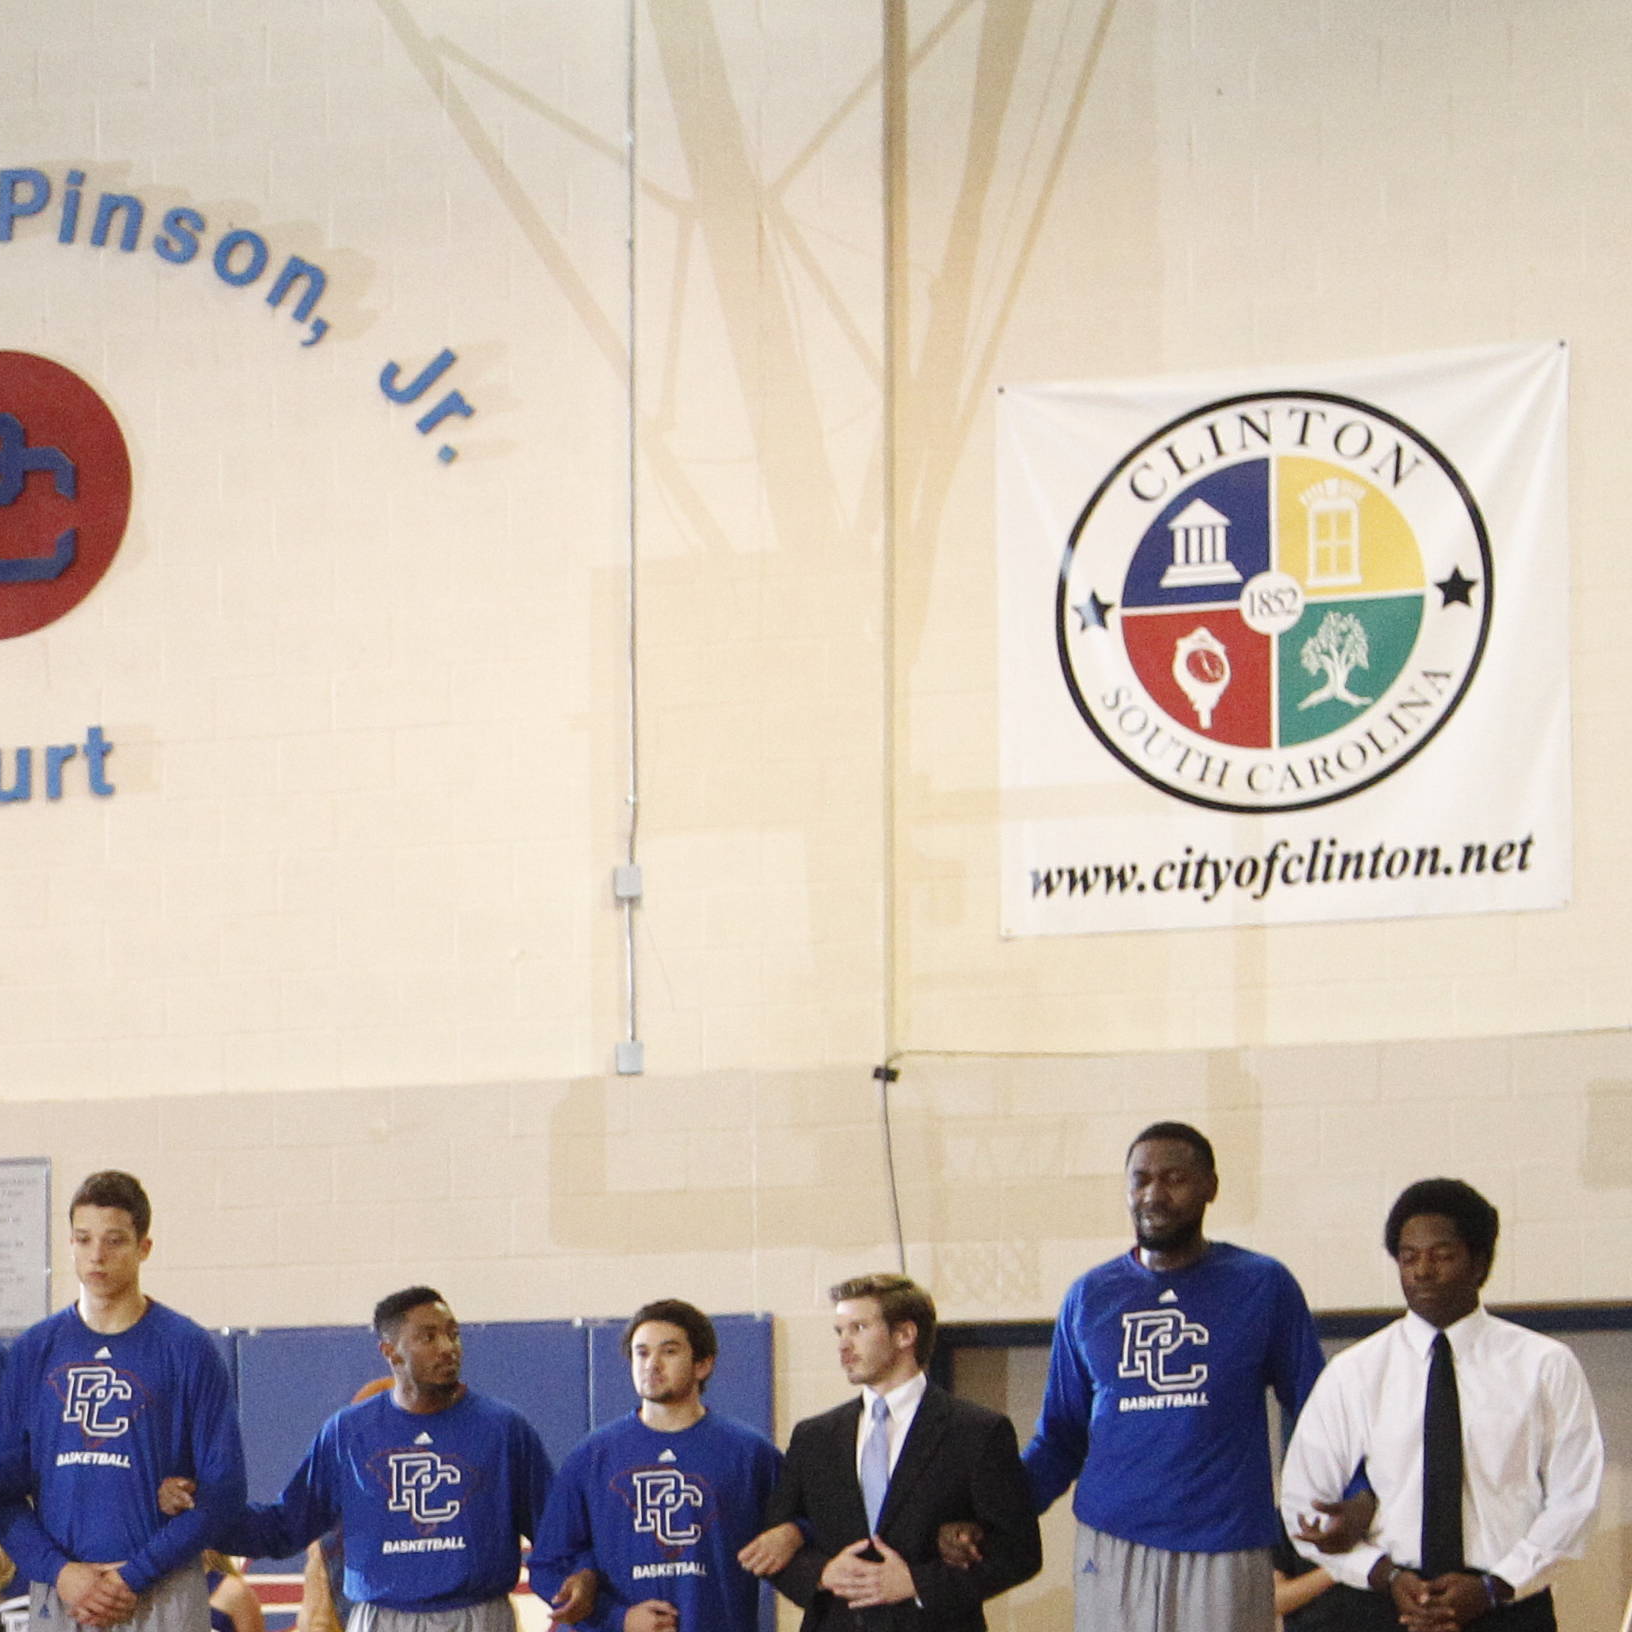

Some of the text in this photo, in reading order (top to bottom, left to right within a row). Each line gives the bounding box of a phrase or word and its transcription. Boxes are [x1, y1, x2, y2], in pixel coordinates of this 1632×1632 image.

[379, 347, 476, 466] Jr.
[1130, 408, 1421, 503] CLINTON
[1247, 588, 1299, 618] 1852
[1101, 667, 1453, 794] SOUTH CAROLINA
[1030, 832, 1535, 903] www.cityofclinton.net
[1117, 1308, 1210, 1392] PC
[62, 1366, 133, 1438] PC
[1118, 1391, 1210, 1413] BASKETBALL
[55, 1451, 132, 1469] BASKETBALL
[387, 1451, 461, 1524] PC
[632, 1468, 703, 1546] PC
[382, 1536, 468, 1555] BASKETBALL
[632, 1561, 708, 1580] BASKETBALL
